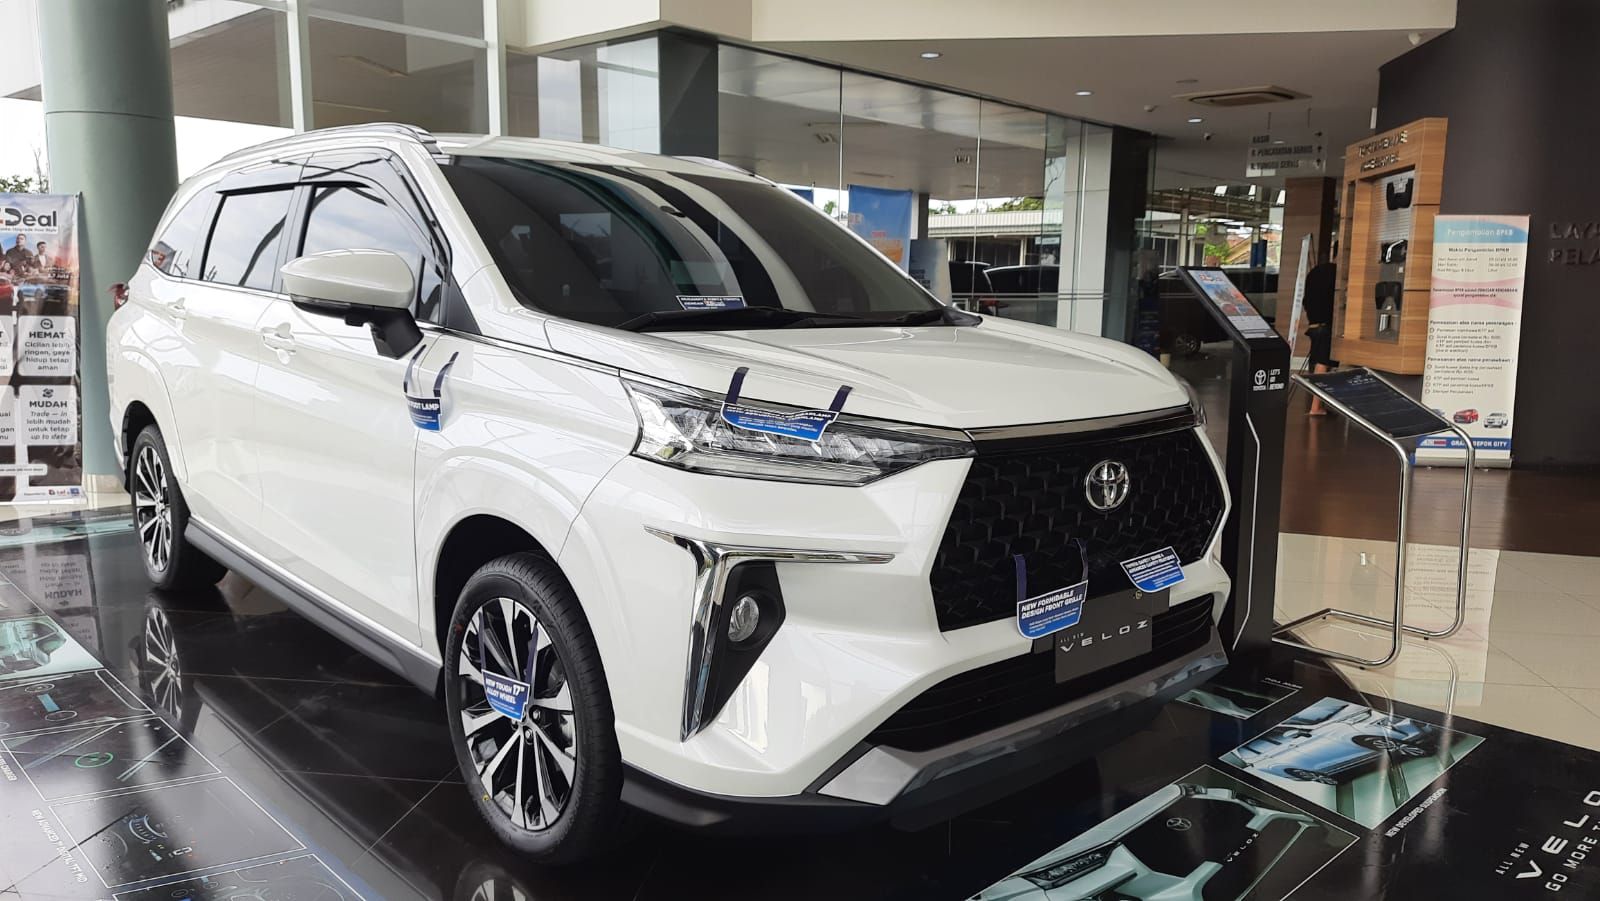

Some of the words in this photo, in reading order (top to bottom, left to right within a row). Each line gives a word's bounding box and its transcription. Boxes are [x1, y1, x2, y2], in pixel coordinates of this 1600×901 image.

[29, 331, 66, 339] HEMAT
[24, 349, 50, 357] ringan,
[26, 356, 48, 364] hidup
[29, 400, 68, 408] MUDAH
[50, 426, 70, 434] tetap
[1021, 602, 1038, 612] NEW
[1037, 589, 1074, 607] FORMIDABLE
[1021, 607, 1045, 619] DESIGN
[1044, 601, 1064, 614] FRONT
[1064, 593, 1083, 607] GRILLE
[1060, 619, 1148, 653] VELOZ
[486, 687, 499, 698] ALLOY
[499, 692, 517, 705] WHEEL
[495, 681, 513, 694] TOUGH
[1384, 826, 1401, 838] NEW
[1395, 806, 1424, 829] DEVELOPED
[1419, 787, 1448, 809] SUSPENSION
[1495, 861, 1513, 875] ALL
[1510, 841, 1530, 859] NEW
[1544, 873, 1568, 892] GO
[1562, 836, 1598, 869] MORE
